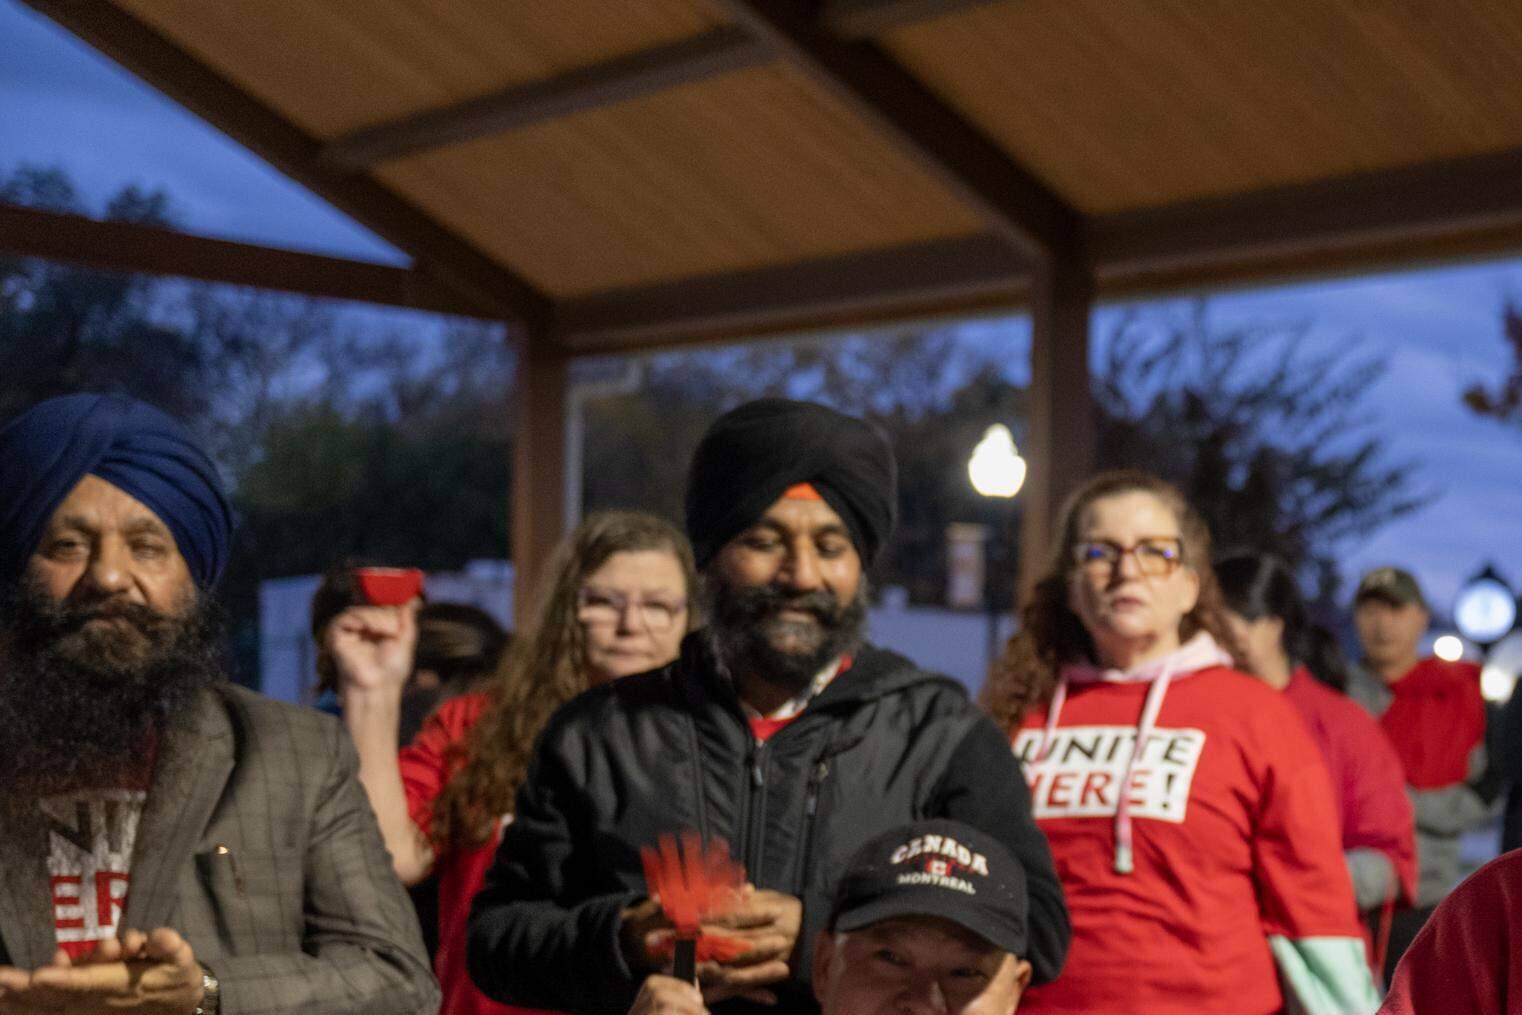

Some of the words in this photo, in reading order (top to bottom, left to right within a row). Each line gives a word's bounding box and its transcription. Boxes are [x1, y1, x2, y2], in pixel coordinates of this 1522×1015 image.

[1018, 734, 1196, 765] UNITE
[890, 834, 989, 876] CANADA
[897, 872, 976, 895] MONTREAL
